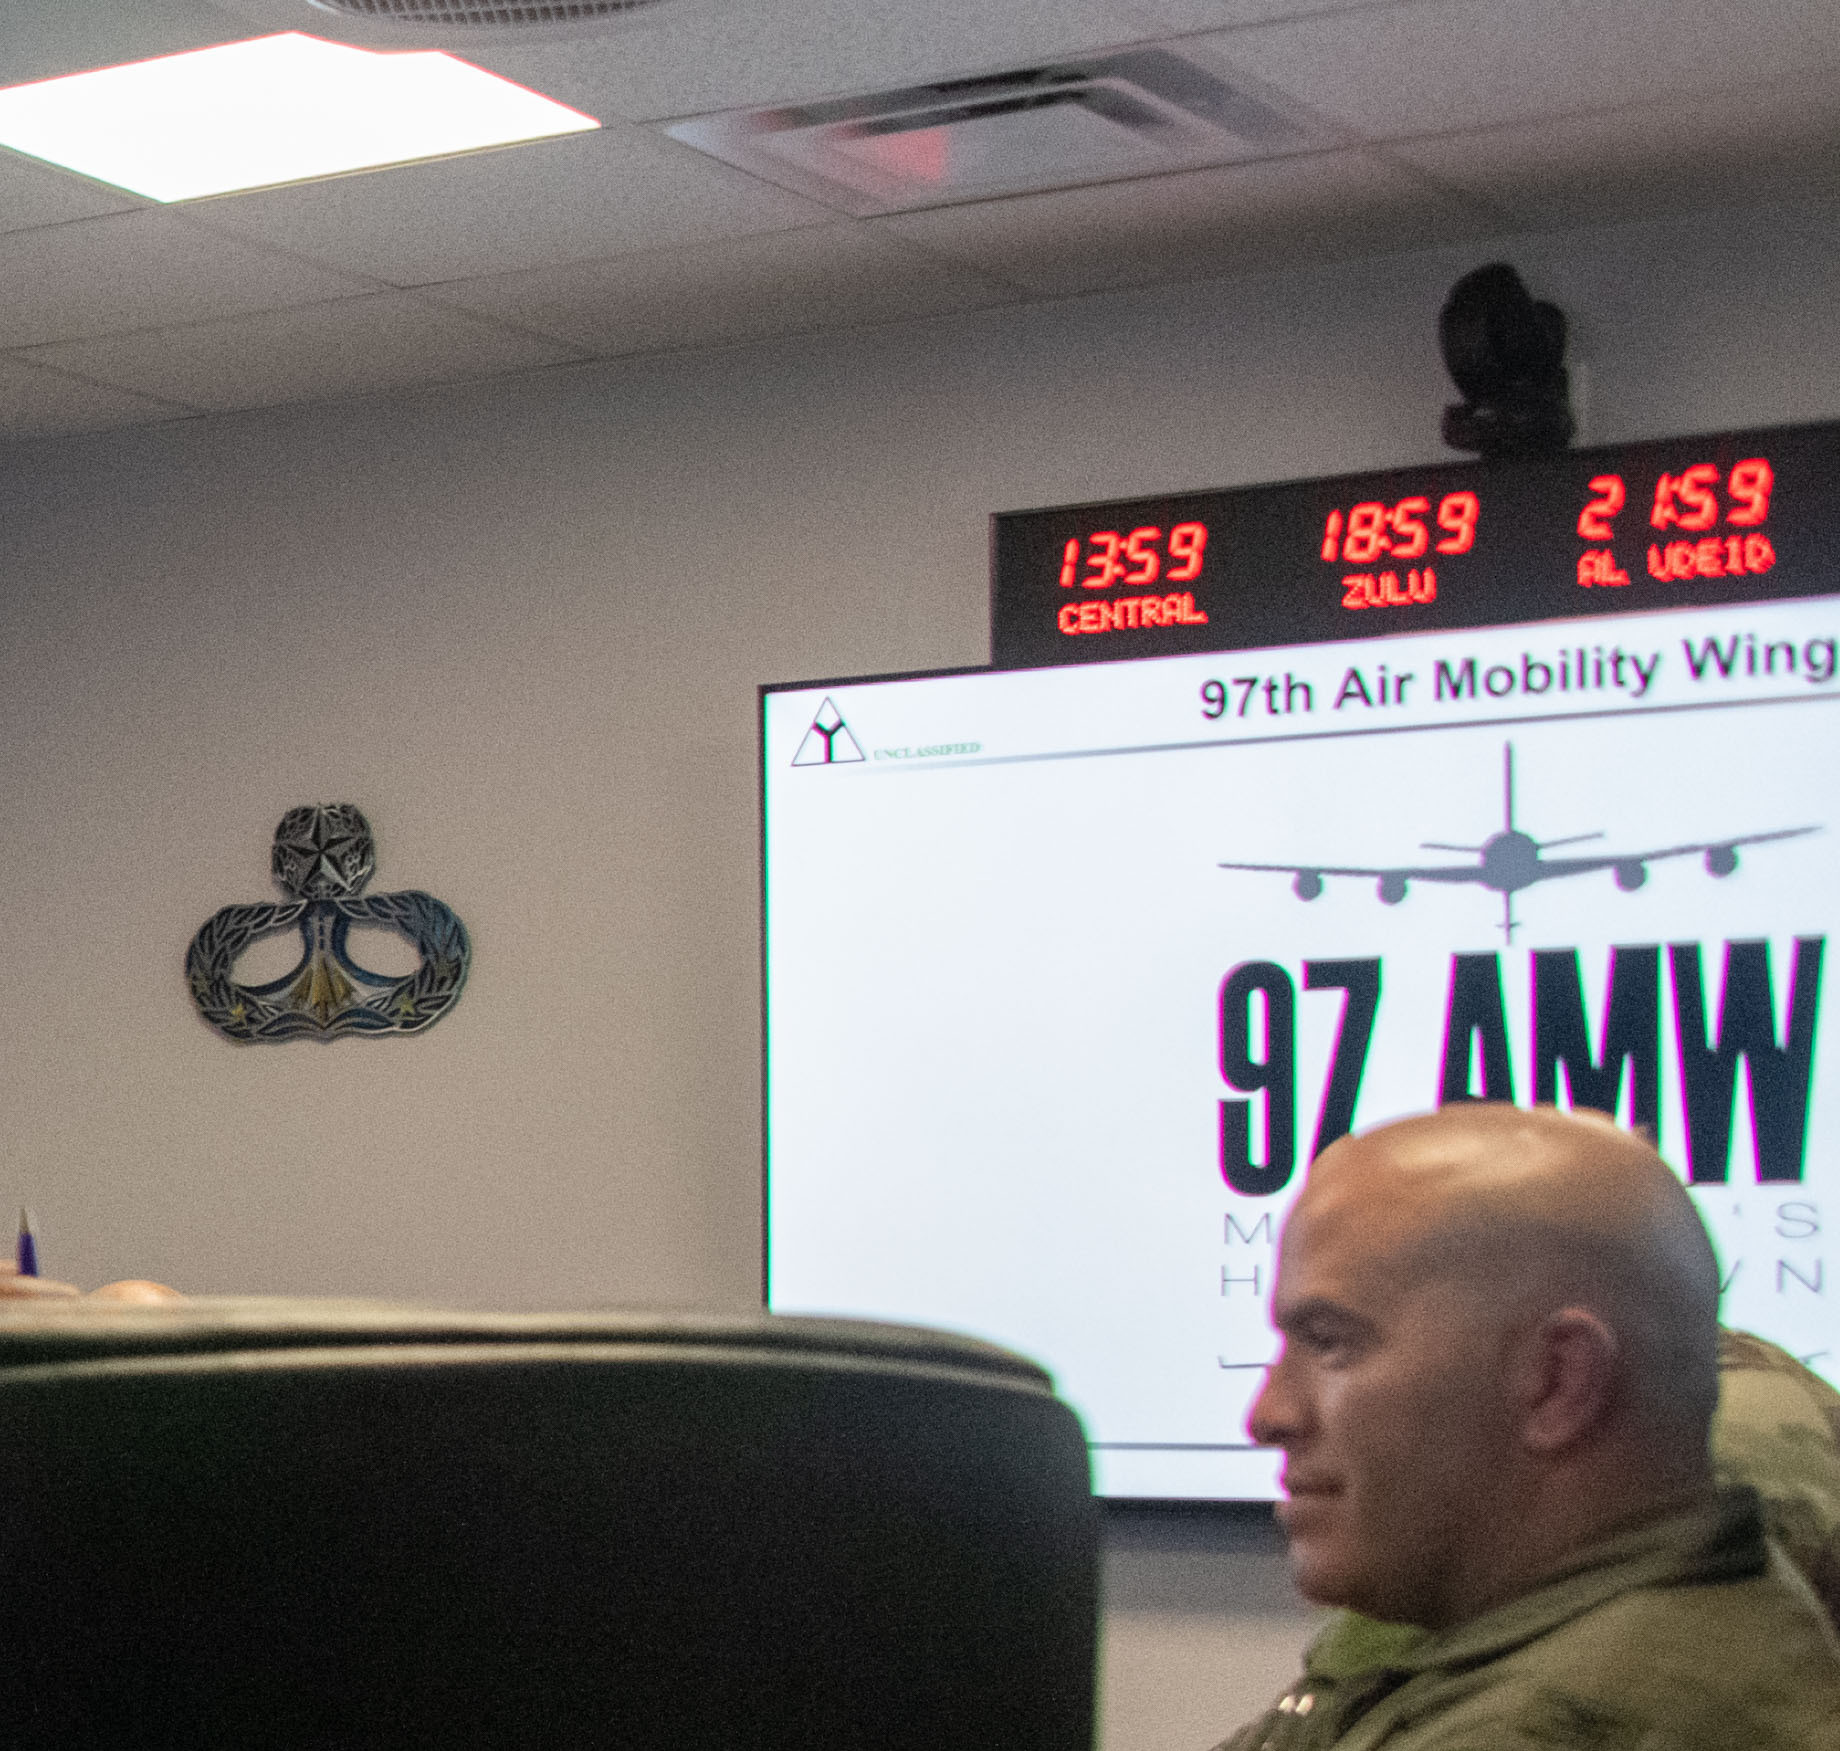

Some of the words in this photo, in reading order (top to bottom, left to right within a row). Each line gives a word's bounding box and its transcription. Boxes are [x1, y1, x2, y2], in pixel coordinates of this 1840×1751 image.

[1321, 490, 1480, 564] 18:59
[1059, 521, 1208, 590] 13:59
[1576, 548, 1631, 588] AL
[1057, 592, 1208, 636] CENTRAL
[1341, 567, 1437, 610] ZULU
[1199, 672, 1314, 722] 97th
[1332, 665, 1415, 710] Air
[1433, 644, 1660, 698] Mobility
[1682, 632, 1839, 684] Wing
[874, 741, 983, 761] UNCLASSIFIED
[1217, 956, 1383, 1198] 97
[1437, 934, 1828, 1185] AMW
